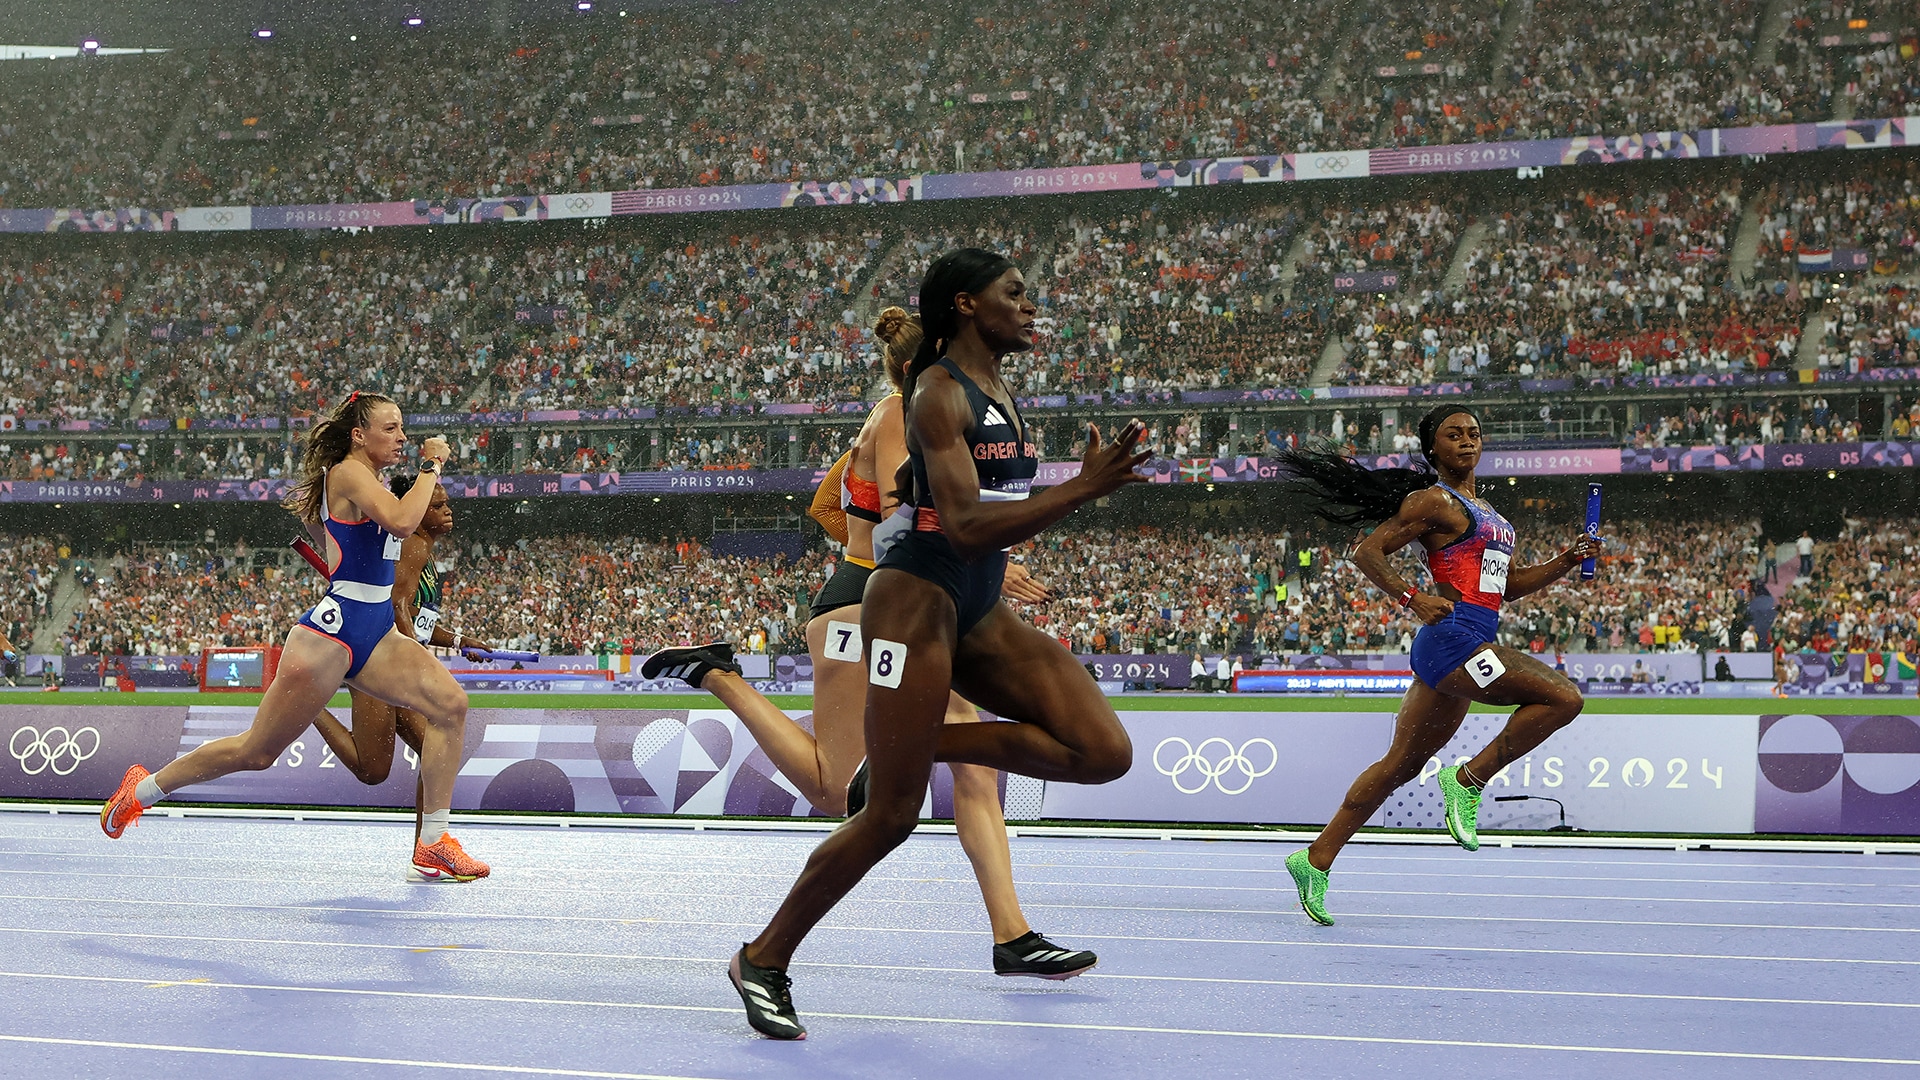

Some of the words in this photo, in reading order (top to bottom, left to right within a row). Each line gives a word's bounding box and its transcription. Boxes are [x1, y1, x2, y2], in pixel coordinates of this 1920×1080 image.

[1408, 151, 1463, 166] PARIS
[1470, 147, 1521, 164] 2024
[1013, 174, 1064, 188] PARIS
[1071, 171, 1119, 186] 2024
[646, 194, 692, 207] PARIS
[698, 191, 741, 206] 2024
[1334, 277, 1355, 288] E10
[973, 441, 1018, 460] GREAT
[1840, 451, 1860, 465] D5
[1494, 456, 1543, 469] PARIS
[1549, 455, 1593, 469] 2024
[500, 482, 514, 494] H3
[543, 482, 559, 493] H2
[671, 476, 712, 488] PARIS
[716, 475, 754, 487] 2024
[38, 486, 80, 497] PARIS
[83, 485, 121, 497] 2024
[193, 487, 209, 498] H4
[321, 608, 336, 625] 6
[837, 629, 853, 653] 7
[877, 649, 893, 677] 8
[1112, 663, 1169, 678] 2024
[1476, 658, 1494, 677] 5
[1587, 756, 1723, 790] 2024
